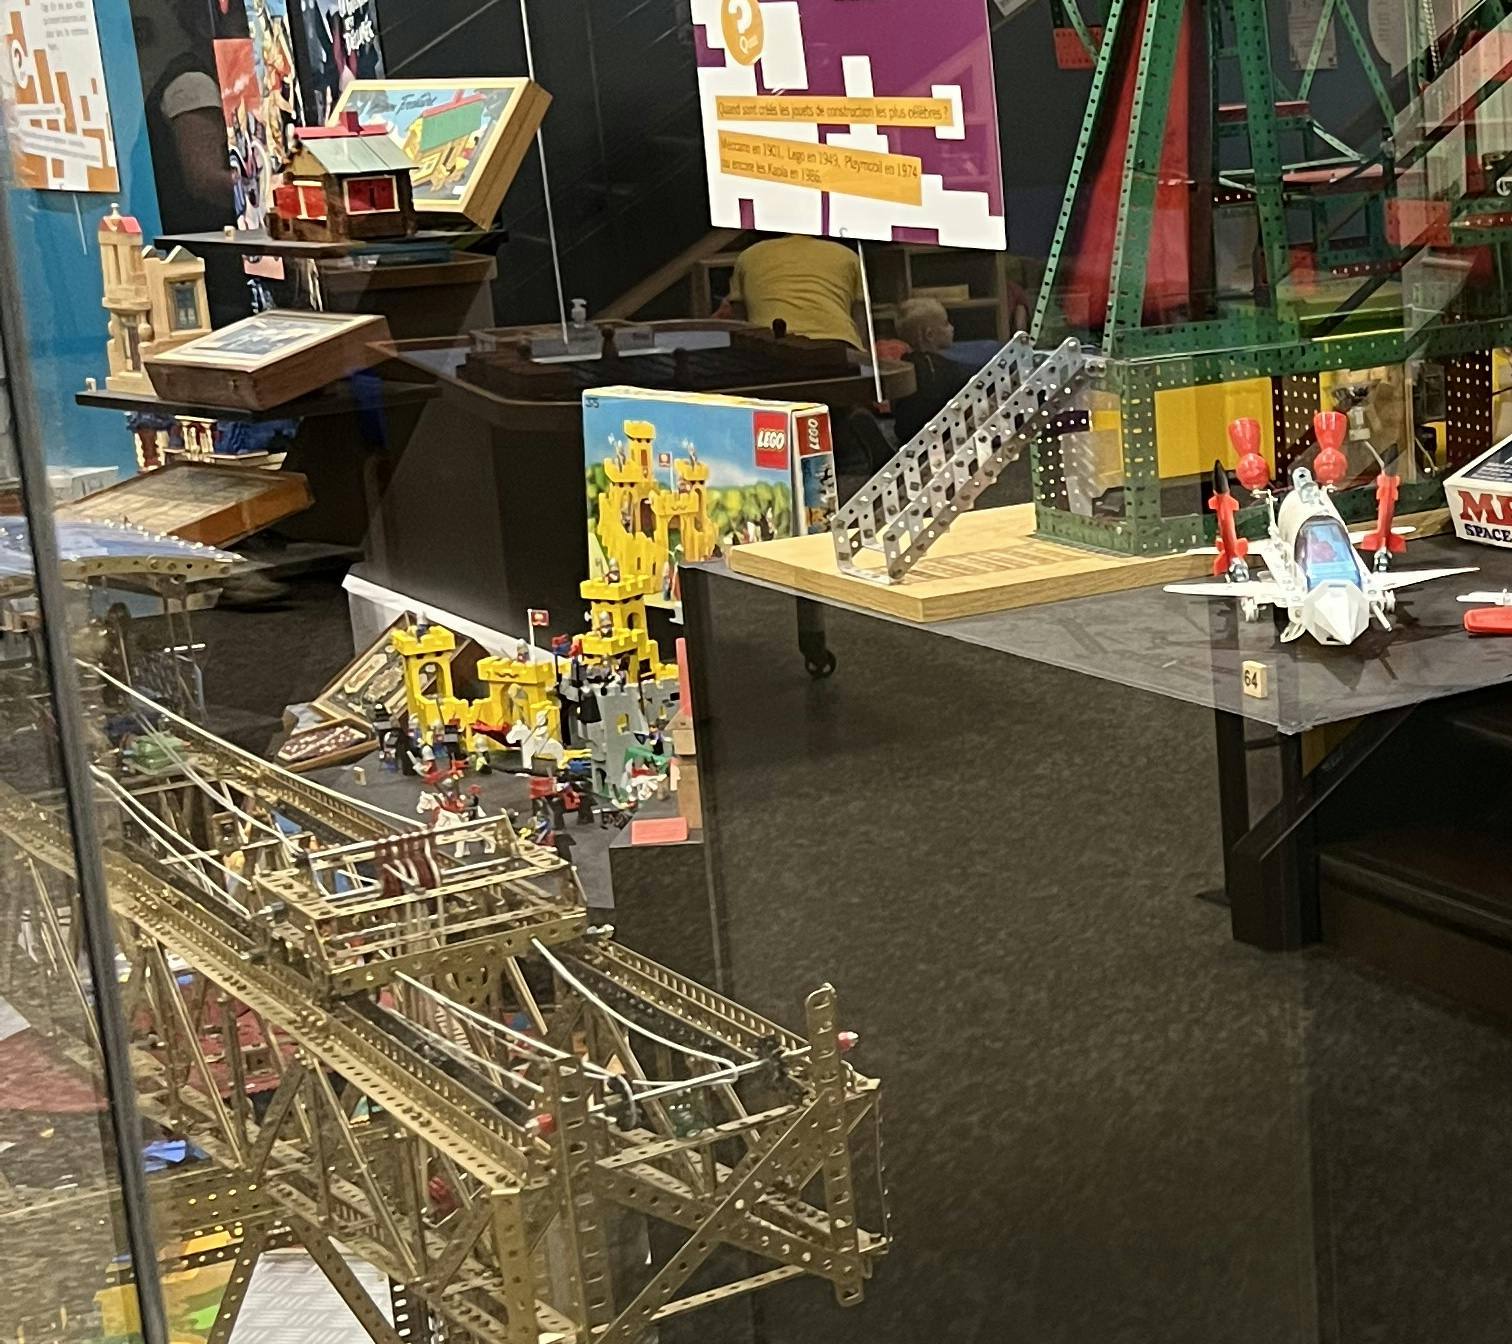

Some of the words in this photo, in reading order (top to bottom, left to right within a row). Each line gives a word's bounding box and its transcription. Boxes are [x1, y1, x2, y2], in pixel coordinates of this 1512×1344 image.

[757, 430, 785, 450] LEGO
[808, 418, 820, 450] LEGO
[1465, 523, 1512, 544] SPACE
[1244, 668, 1259, 689] 64
